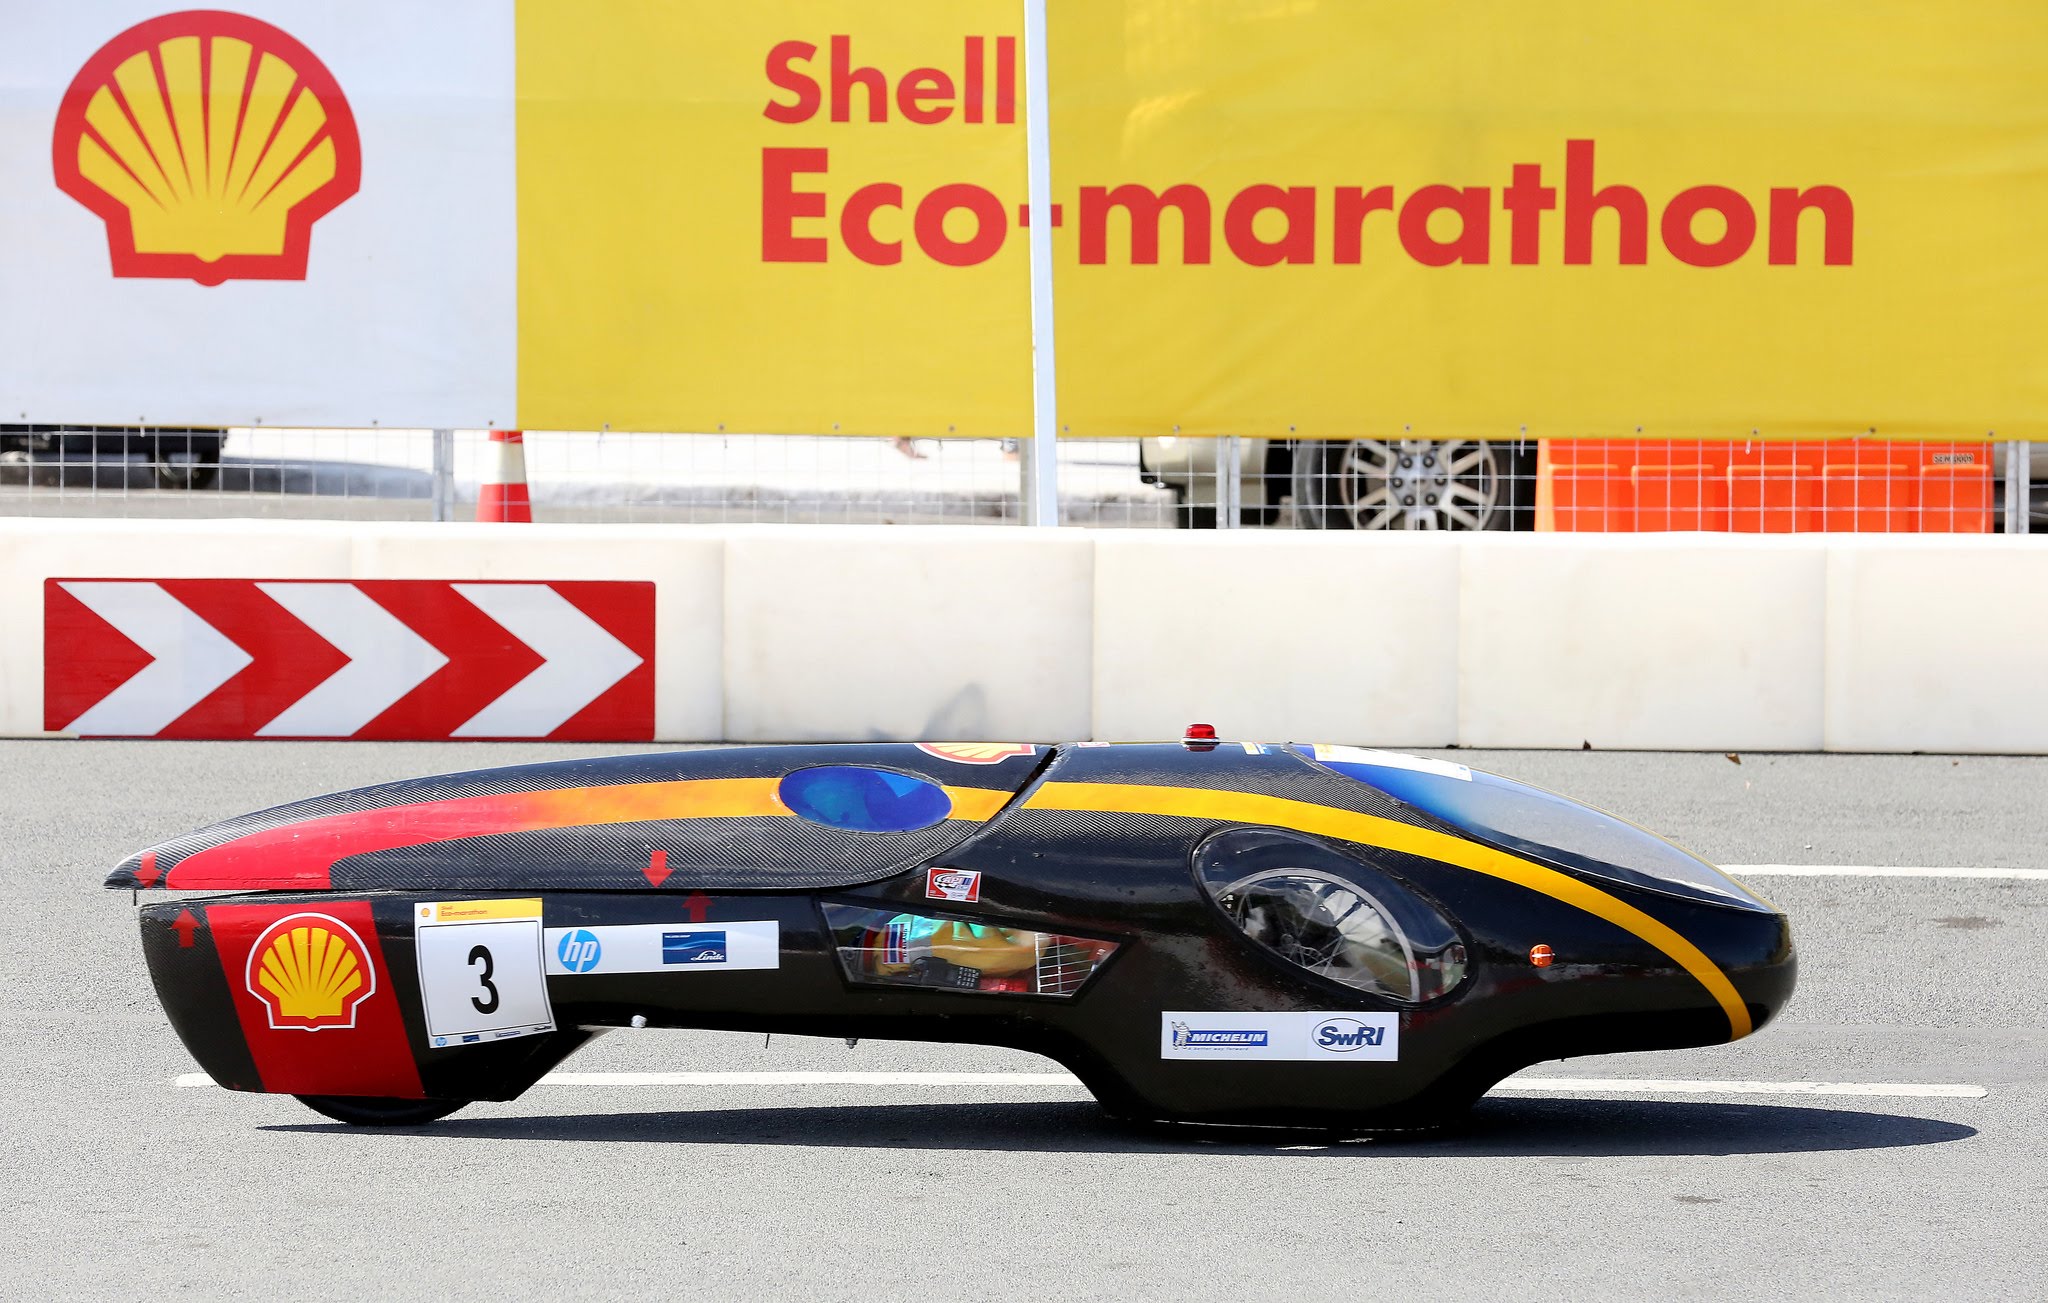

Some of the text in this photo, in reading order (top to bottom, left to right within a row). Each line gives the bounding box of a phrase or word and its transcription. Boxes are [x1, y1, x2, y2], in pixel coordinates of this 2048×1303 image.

[762, 35, 1016, 125] Shell
[761, 139, 1854, 267] Eco-marathon
[441, 909, 488, 917] Eco-marathon
[561, 930, 599, 973] hp
[691, 950, 725, 961] Linde
[468, 945, 499, 1014] 3
[1191, 1033, 1265, 1042] MICHELIN
[1318, 1026, 1386, 1046] SwRI
